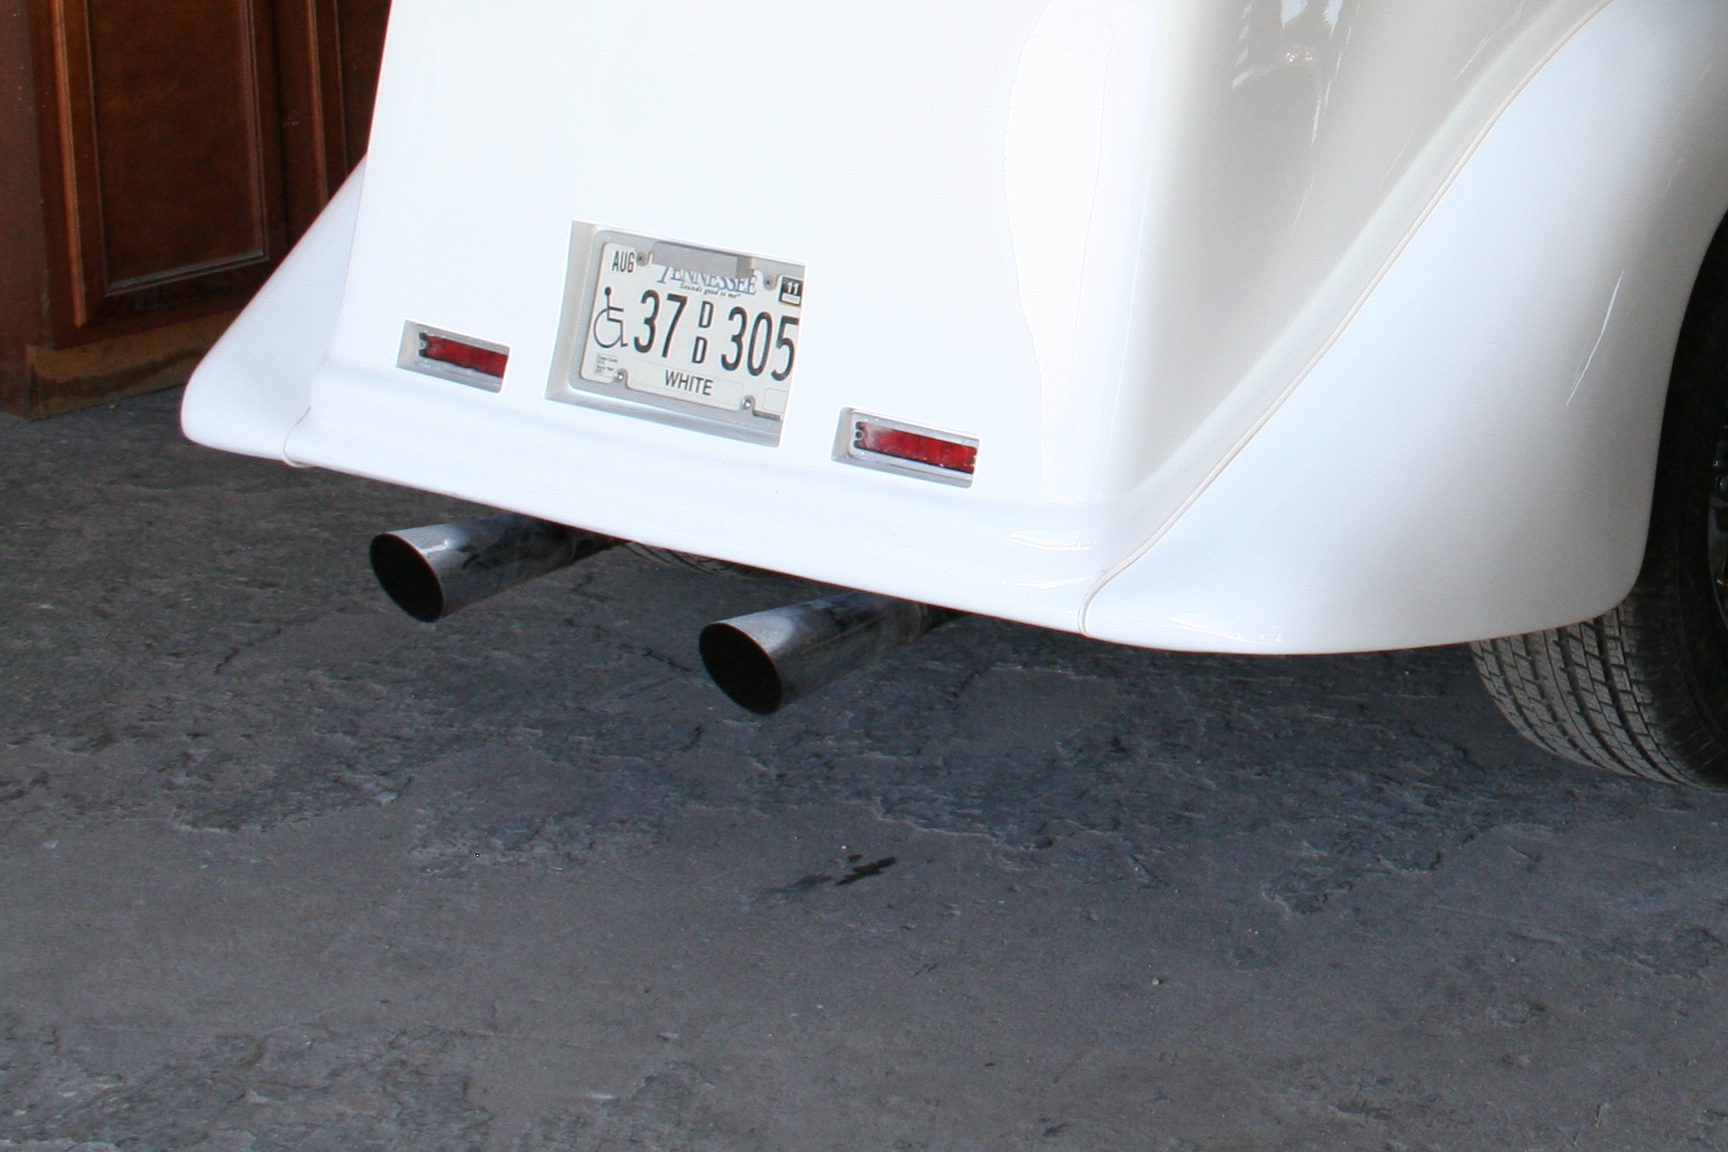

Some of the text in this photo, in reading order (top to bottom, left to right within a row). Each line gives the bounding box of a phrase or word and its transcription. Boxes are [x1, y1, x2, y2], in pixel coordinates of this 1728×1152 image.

[611, 250, 635, 274] AUG
[633, 288, 800, 382] 37 D D 305
[664, 369, 715, 396] WHITE
